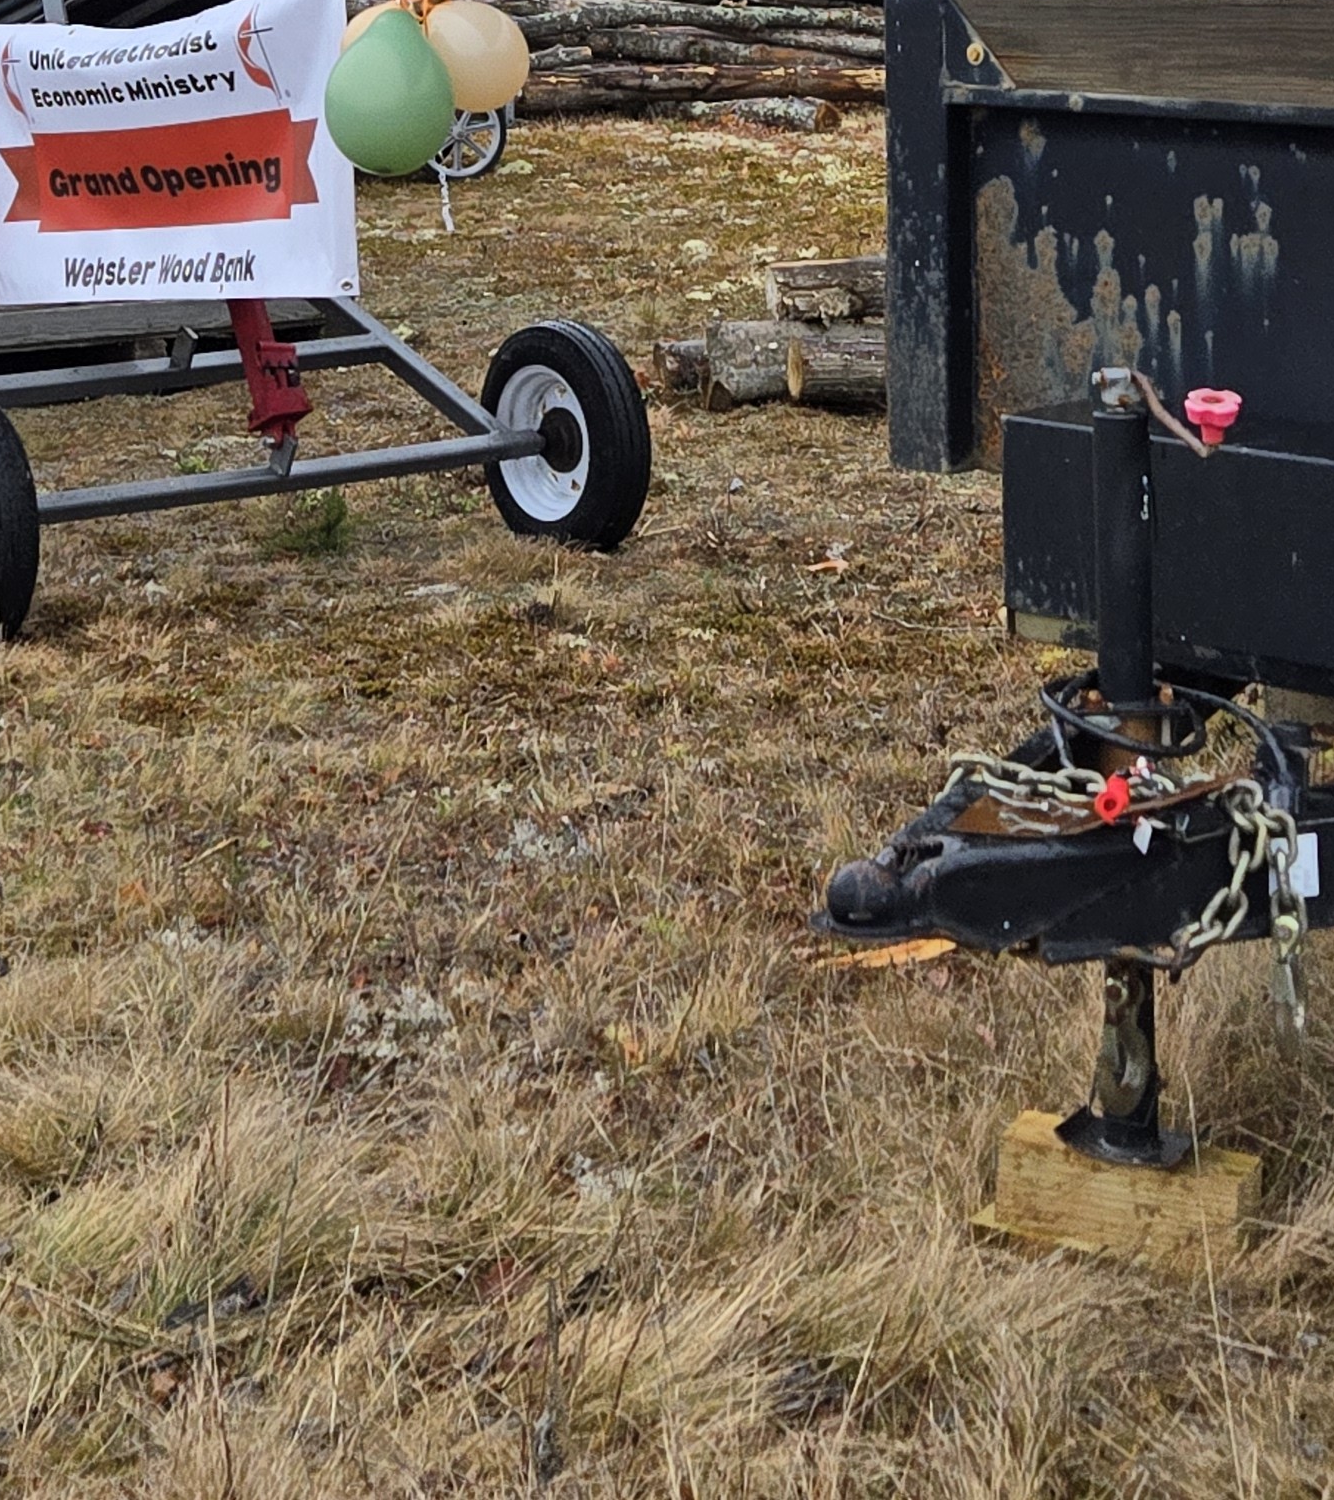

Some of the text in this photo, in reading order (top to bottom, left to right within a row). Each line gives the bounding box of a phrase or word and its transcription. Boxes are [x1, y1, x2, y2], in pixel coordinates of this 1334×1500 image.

[28, 30, 217, 70] United Methodist
[31, 71, 236, 108] Economic Ministry
[49, 152, 281, 197] Grand Opening
[64, 249, 257, 292] Webster Wood Bank
